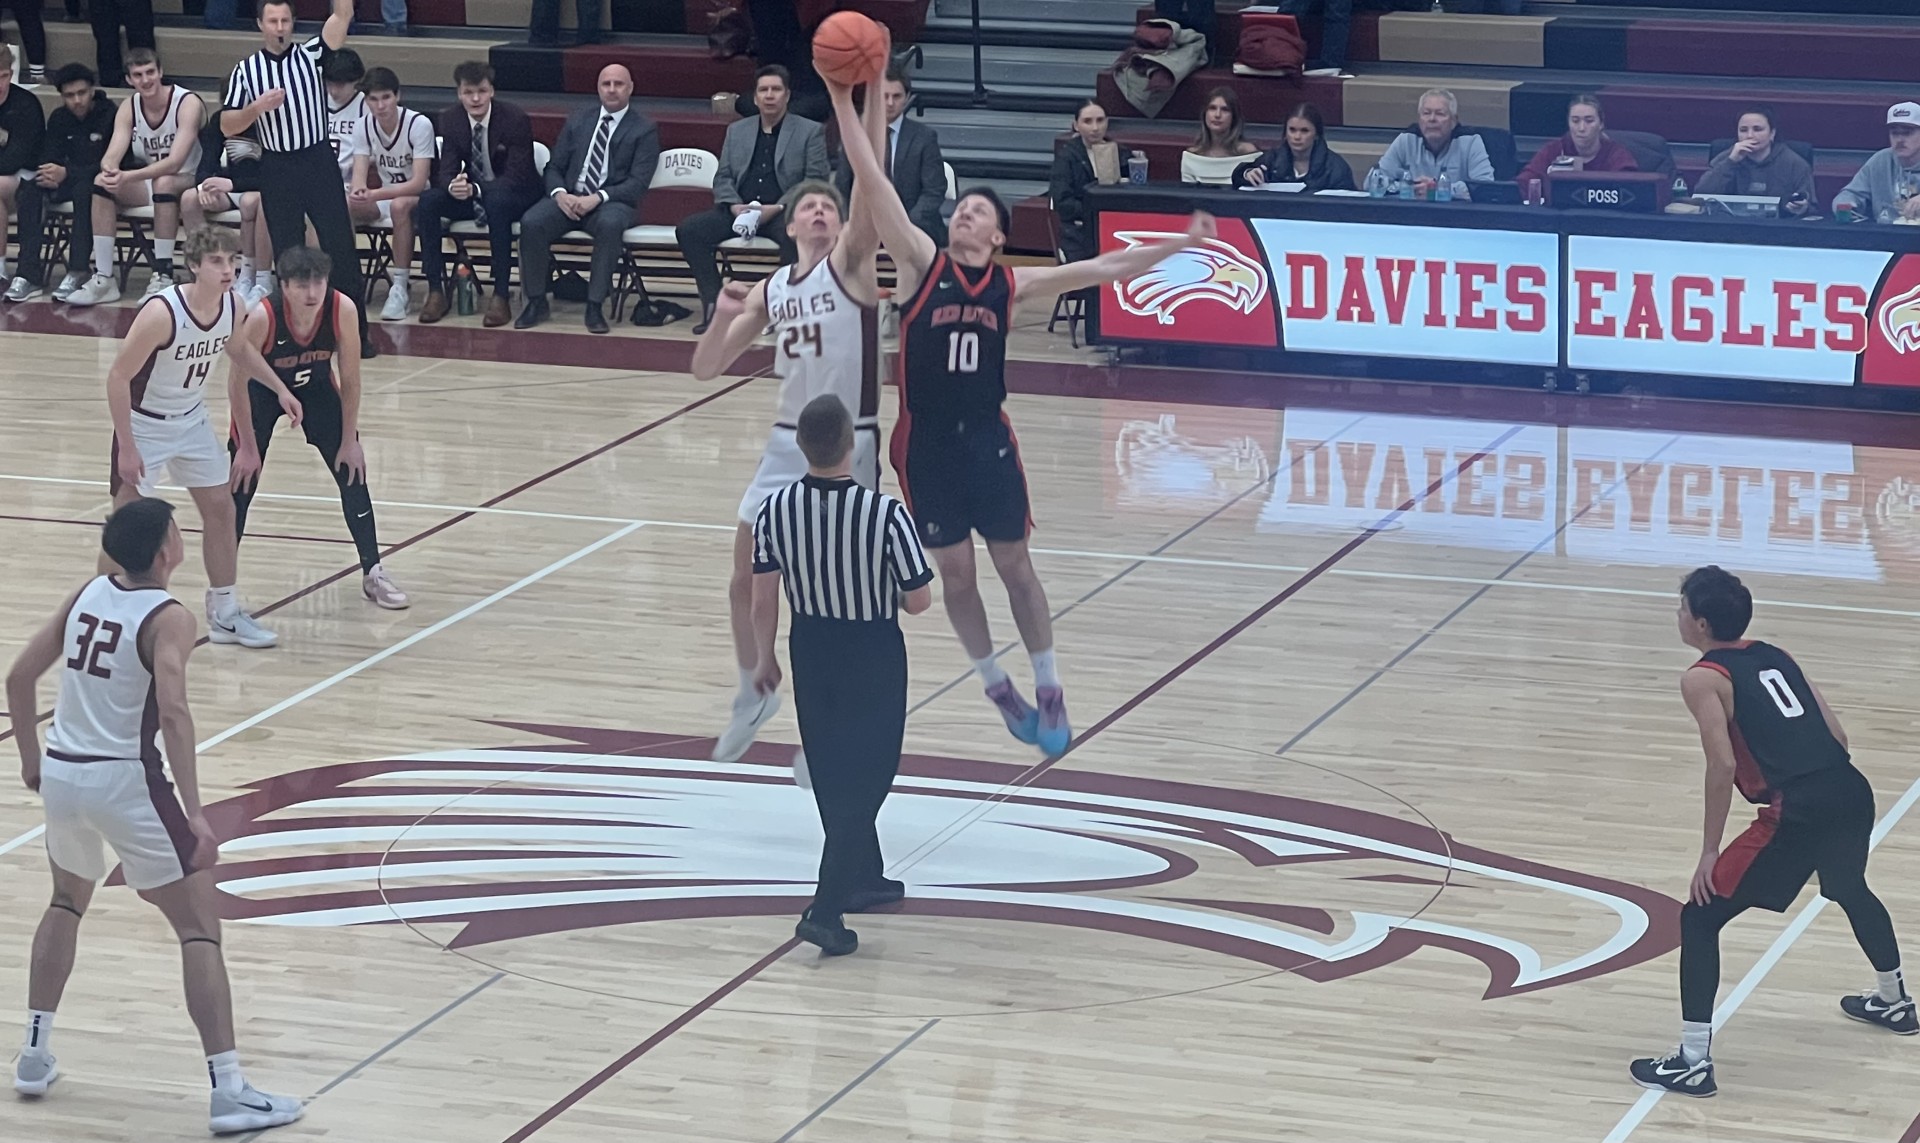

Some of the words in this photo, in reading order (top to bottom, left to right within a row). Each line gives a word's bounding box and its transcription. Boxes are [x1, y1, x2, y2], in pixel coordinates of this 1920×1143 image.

[379, 153, 414, 169] AGLES
[665, 153, 703, 170] DAVIES
[1587, 189, 1619, 204] POSS
[1284, 251, 1547, 333] DAVIES
[1573, 268, 1868, 354] EAGLES
[783, 322, 823, 359] 24
[947, 331, 980, 374] 10
[182, 361, 211, 389] 14
[293, 369, 313, 388] 5
[66, 612, 123, 680] 32
[1758, 668, 1805, 718] 0
